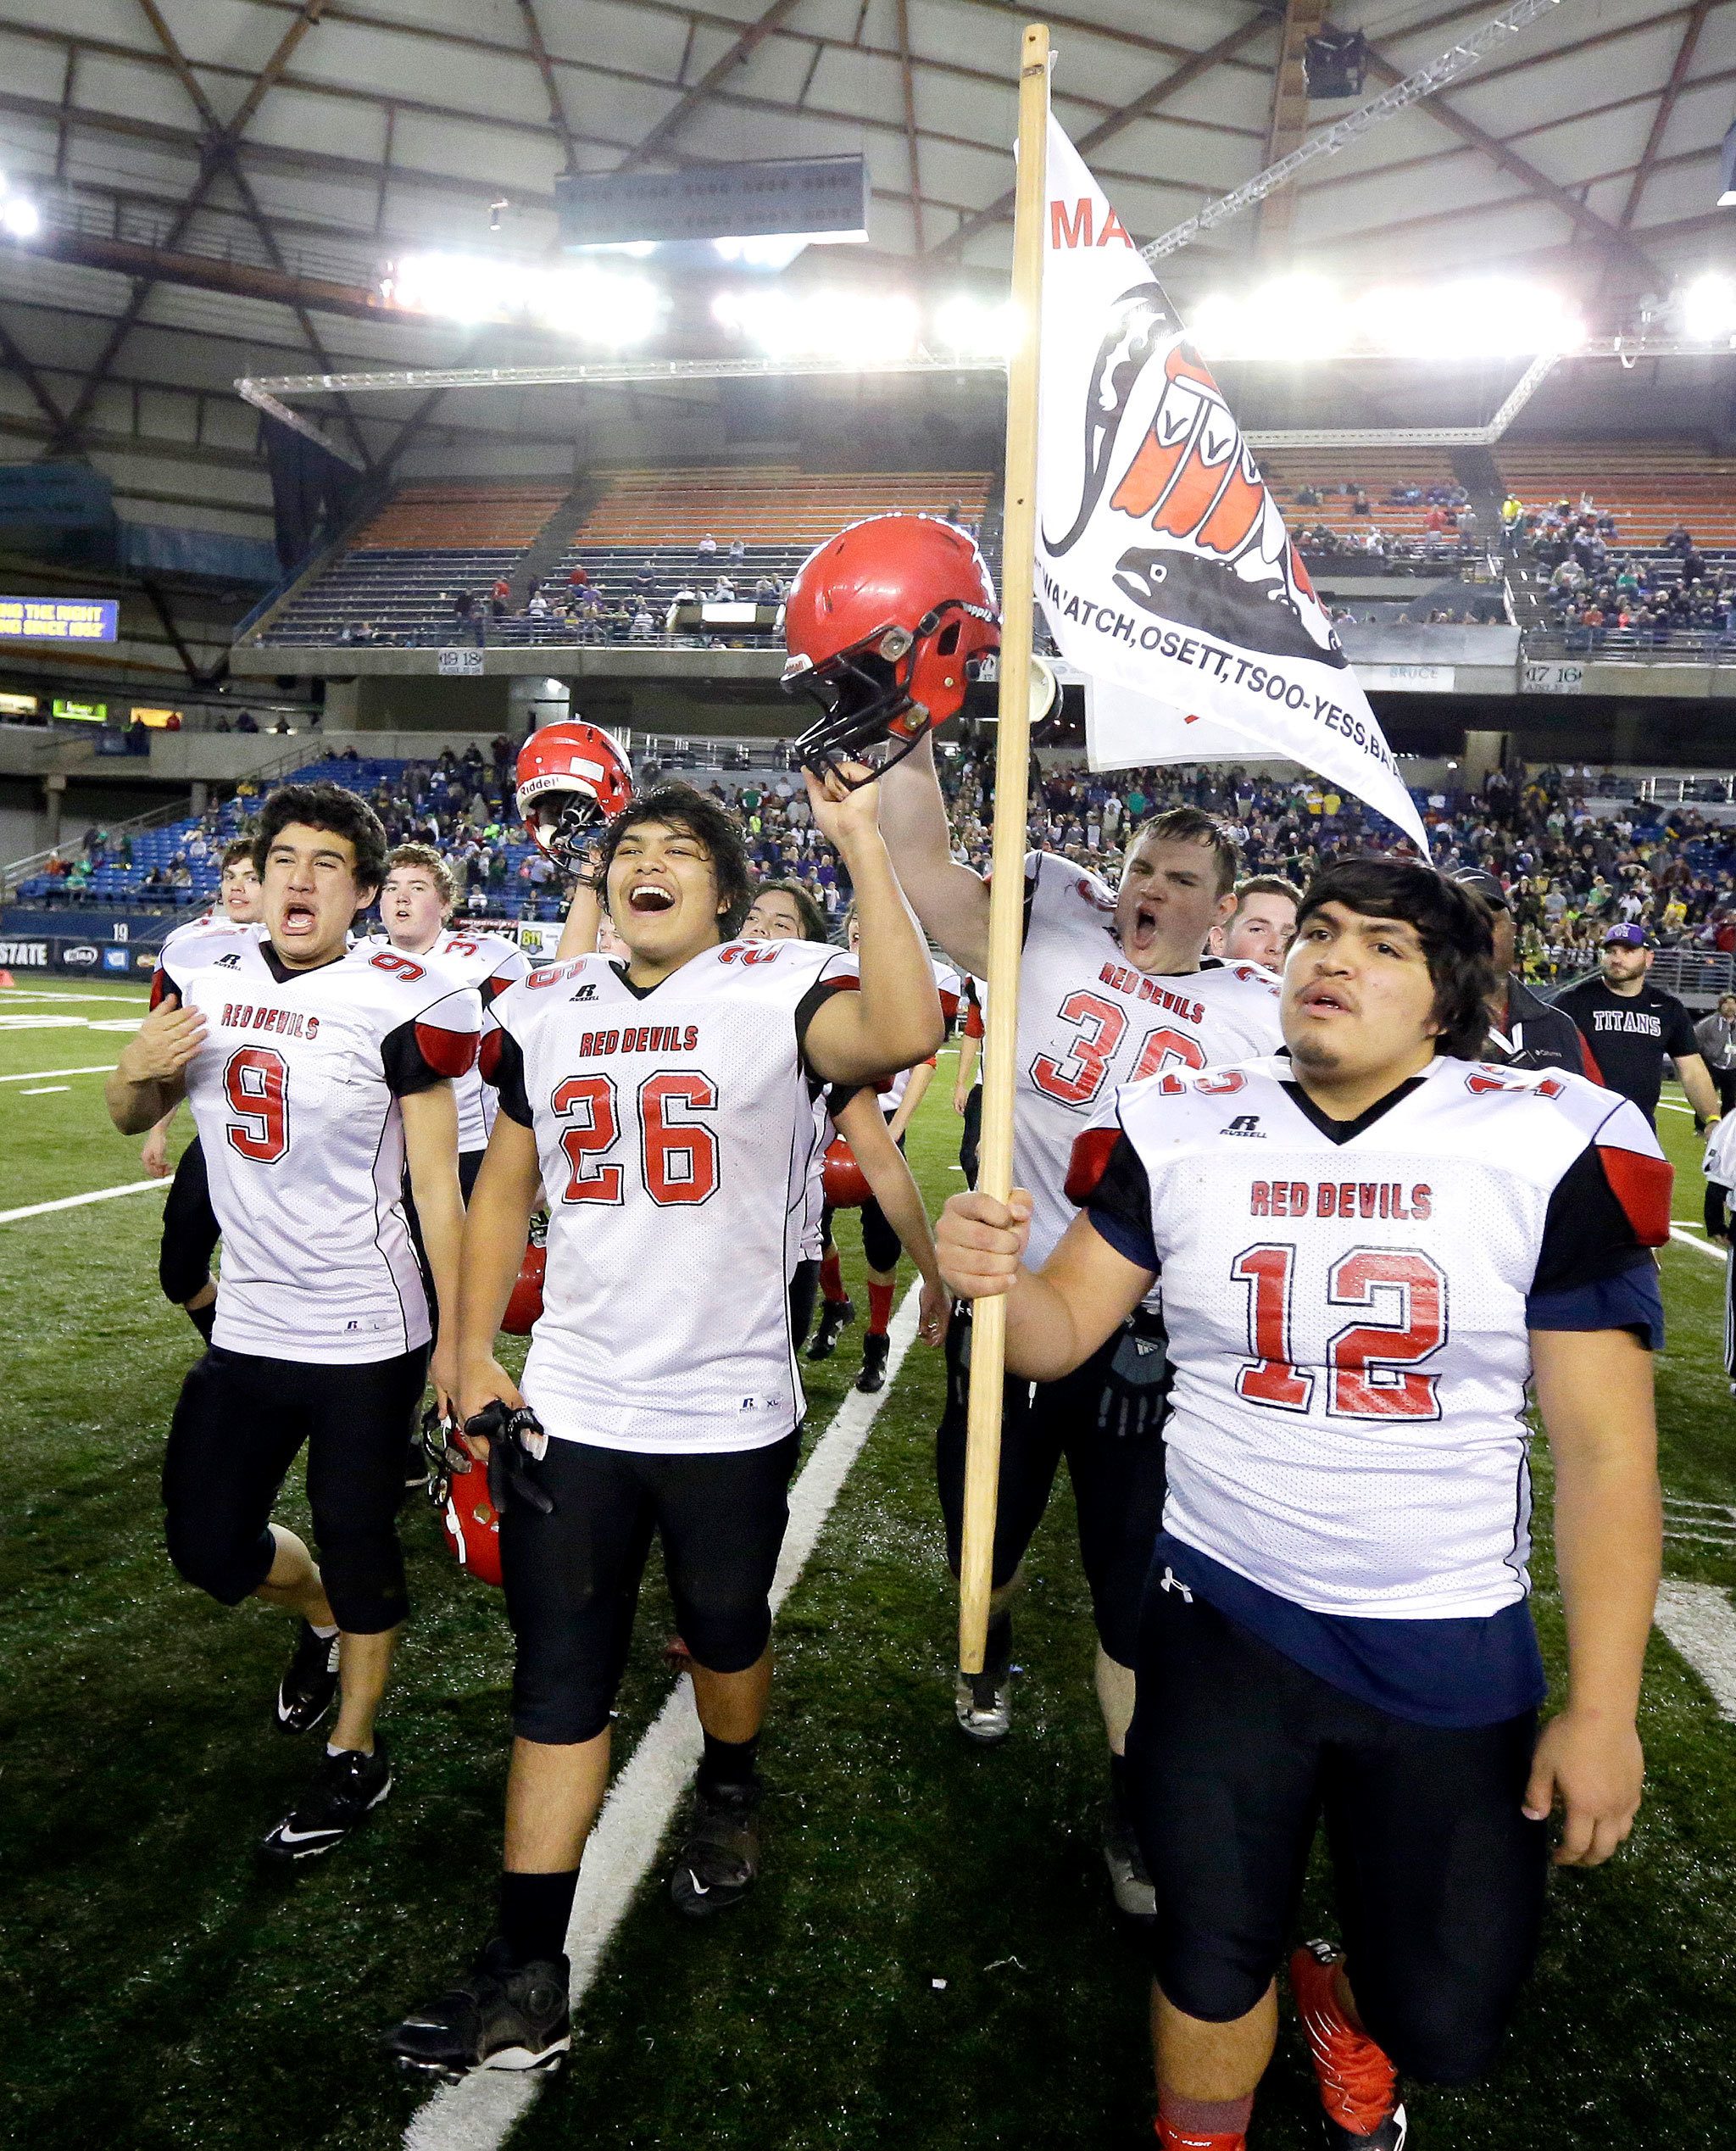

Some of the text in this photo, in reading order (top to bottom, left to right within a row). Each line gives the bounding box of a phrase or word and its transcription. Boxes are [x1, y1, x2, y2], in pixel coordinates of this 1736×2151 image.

[0, 942, 47, 966] STATE
[1099, 961, 1140, 995] RED
[1138, 978, 1205, 1024] DEVILS
[221, 1003, 320, 1039] RED DEVILS
[579, 1025, 698, 1057] RED DEVILS
[1593, 1010, 1661, 1037] TITANS
[223, 1044, 290, 1165] 9
[551, 1069, 721, 1207] 26
[1250, 1179, 1433, 1220] RED DEVILS
[1231, 1241, 1449, 1421] 12
